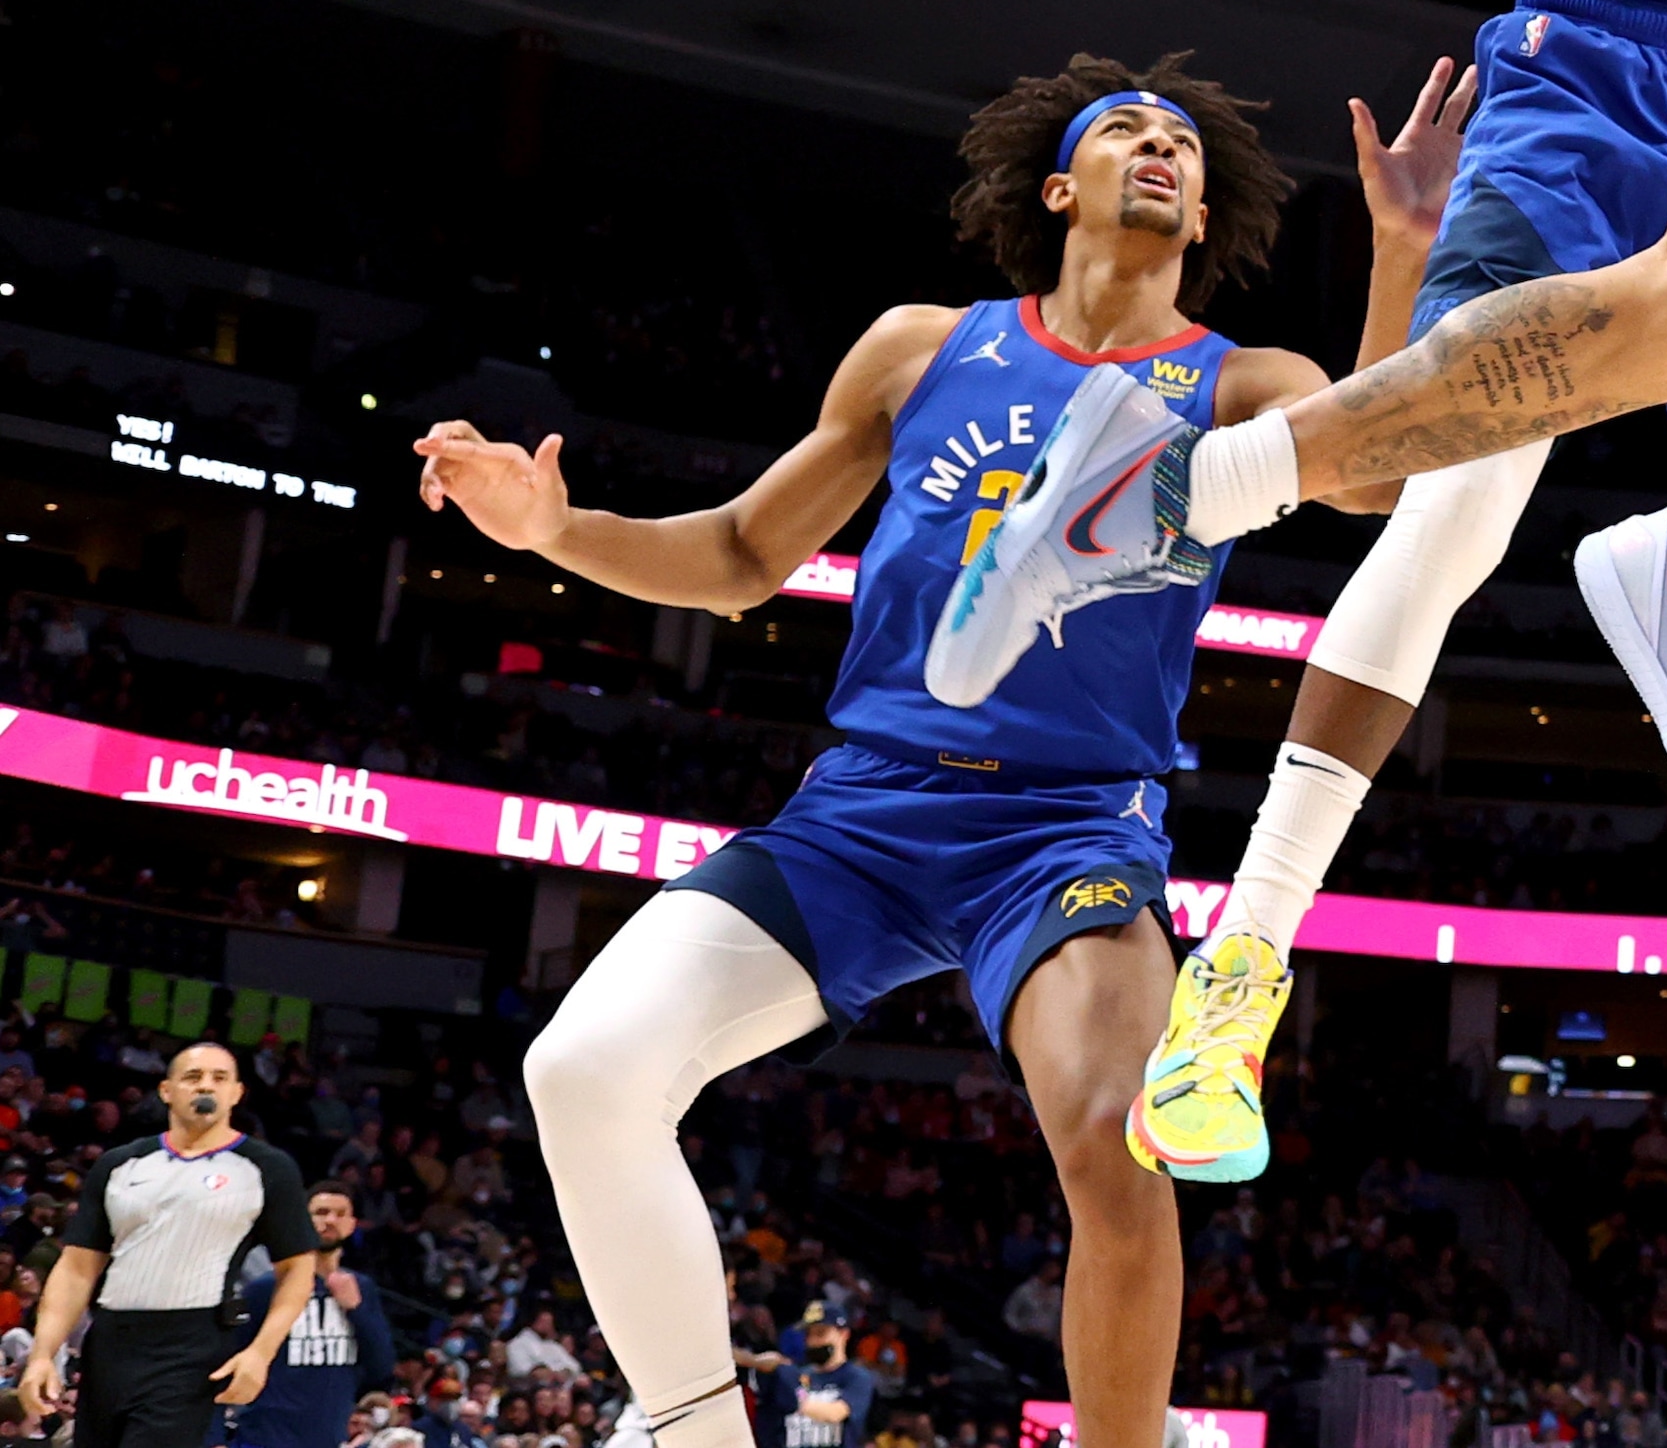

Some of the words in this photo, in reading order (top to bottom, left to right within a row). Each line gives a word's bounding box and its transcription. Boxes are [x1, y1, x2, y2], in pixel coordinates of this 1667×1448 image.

[1153, 357, 1201, 386] WU
[271, 472, 305, 498] TO
[921, 403, 1035, 503] MILE
[146, 748, 390, 834] uchealth
[496, 796, 646, 876] LIVE
